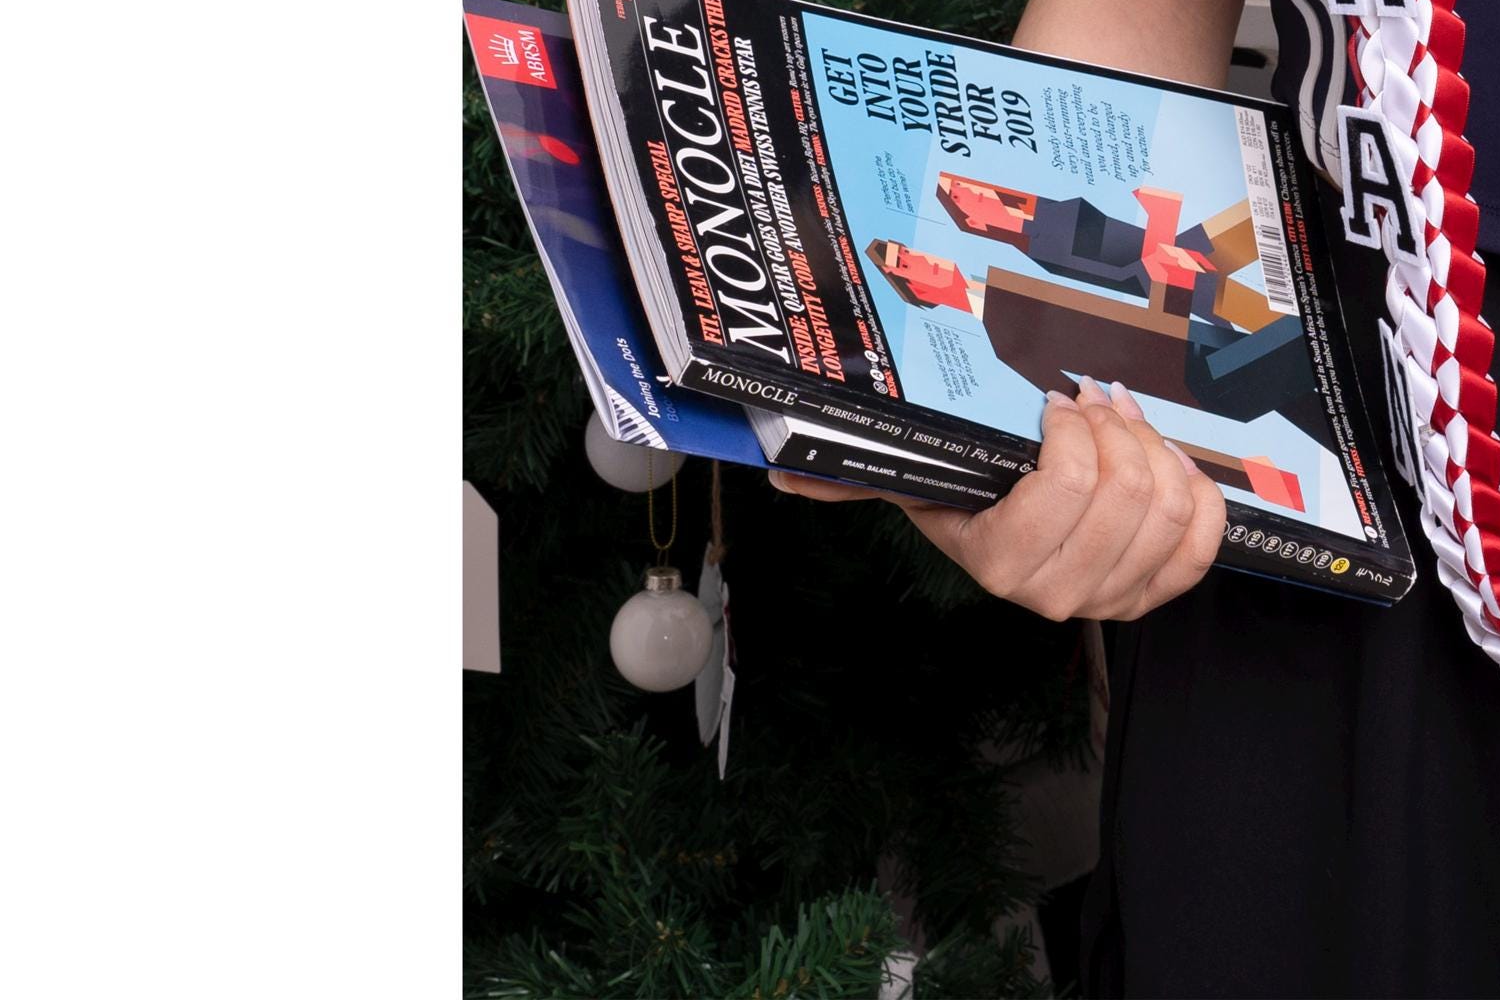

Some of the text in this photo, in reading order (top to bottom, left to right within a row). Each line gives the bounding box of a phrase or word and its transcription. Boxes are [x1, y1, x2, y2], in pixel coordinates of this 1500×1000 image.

[521, 28, 548, 83] ABRSM
[710, 27, 737, 88] CRACKS
[821, 48, 859, 106] GET
[856, 52, 896, 123] INTO
[892, 56, 933, 133] YOUR
[925, 50, 971, 157] STRIDE
[722, 90, 752, 152] MADRID
[965, 82, 1002, 144] FOR
[1000, 89, 1037, 153] 2019
[1270, 120, 1278, 130] its
[1041, 86, 1064, 170] Speedy deliveries,
[1057, 88, 1079, 174] very fast-running
[1071, 83, 1095, 186] retail and everything
[1087, 103, 1111, 176] you need to be
[1100, 101, 1126, 182] primed, charged
[1270, 130, 1280, 143] off
[1117, 111, 1139, 178] up and ready
[1135, 124, 1154, 176] for action.
[1274, 143, 1285, 167] shows
[1283, 131, 1294, 161] grocers.
[737, 151, 762, 188] DIET
[1288, 162, 1297, 184] nicest
[645, 17, 789, 360] MONOCLE
[747, 189, 766, 201] A
[1278, 168, 1290, 201] Chicago
[1341, 108, 1425, 264] A
[734, 36, 845, 381] LONGEVITY CODE ANOTHER SWISS TENNIS STAR
[750, 199, 773, 222] ON
[1283, 201, 1293, 224] GUIDE
[1291, 186, 1304, 219] Lisbon's
[647, 141, 723, 345] FIT, LEAN & SHARP SPECIAL
[758, 224, 785, 262] GOES
[1287, 225, 1297, 242] CITY
[1297, 219, 1307, 242] CLASS
[1301, 243, 1309, 252] IN
[1303, 252, 1312, 271] BEST
[771, 263, 805, 313] QATAR
[1297, 276, 1310, 304] Spain's
[1306, 272, 1318, 296] ahead
[1303, 304, 1312, 313] to
[1313, 296, 1323, 314] year
[1305, 314, 1317, 339] Africa
[1316, 315, 1325, 328] the
[1318, 329, 1328, 342] for
[789, 315, 820, 374] INSIDE:
[1310, 339, 1322, 364] South
[1321, 342, 1334, 368] limber
[616, 337, 661, 419] Joining the Dots
[1316, 364, 1325, 374] in
[1328, 368, 1339, 385] you
[702, 367, 797, 405] MONOCLE
[1332, 385, 1343, 403] keep
[1324, 395, 1336, 415] from
[1337, 404, 1346, 413] to
[821, 404, 902, 436] FEBRUARY 2019
[1340, 414, 1354, 440] regime
[913, 431, 963, 453] ISSUE 120
[1347, 441, 1357, 449] A
[842, 458, 898, 478] BRAND. BALANCE.
[970, 447, 1033, 475] Fit, Lean &
[1342, 452, 1356, 472] great
[902, 472, 999, 500] BRAND DOCUMENTARY MAGAZINE
[1349, 472, 1360, 489] Five
[1360, 478, 1374, 500] streak
[1368, 501, 1389, 548] independent
